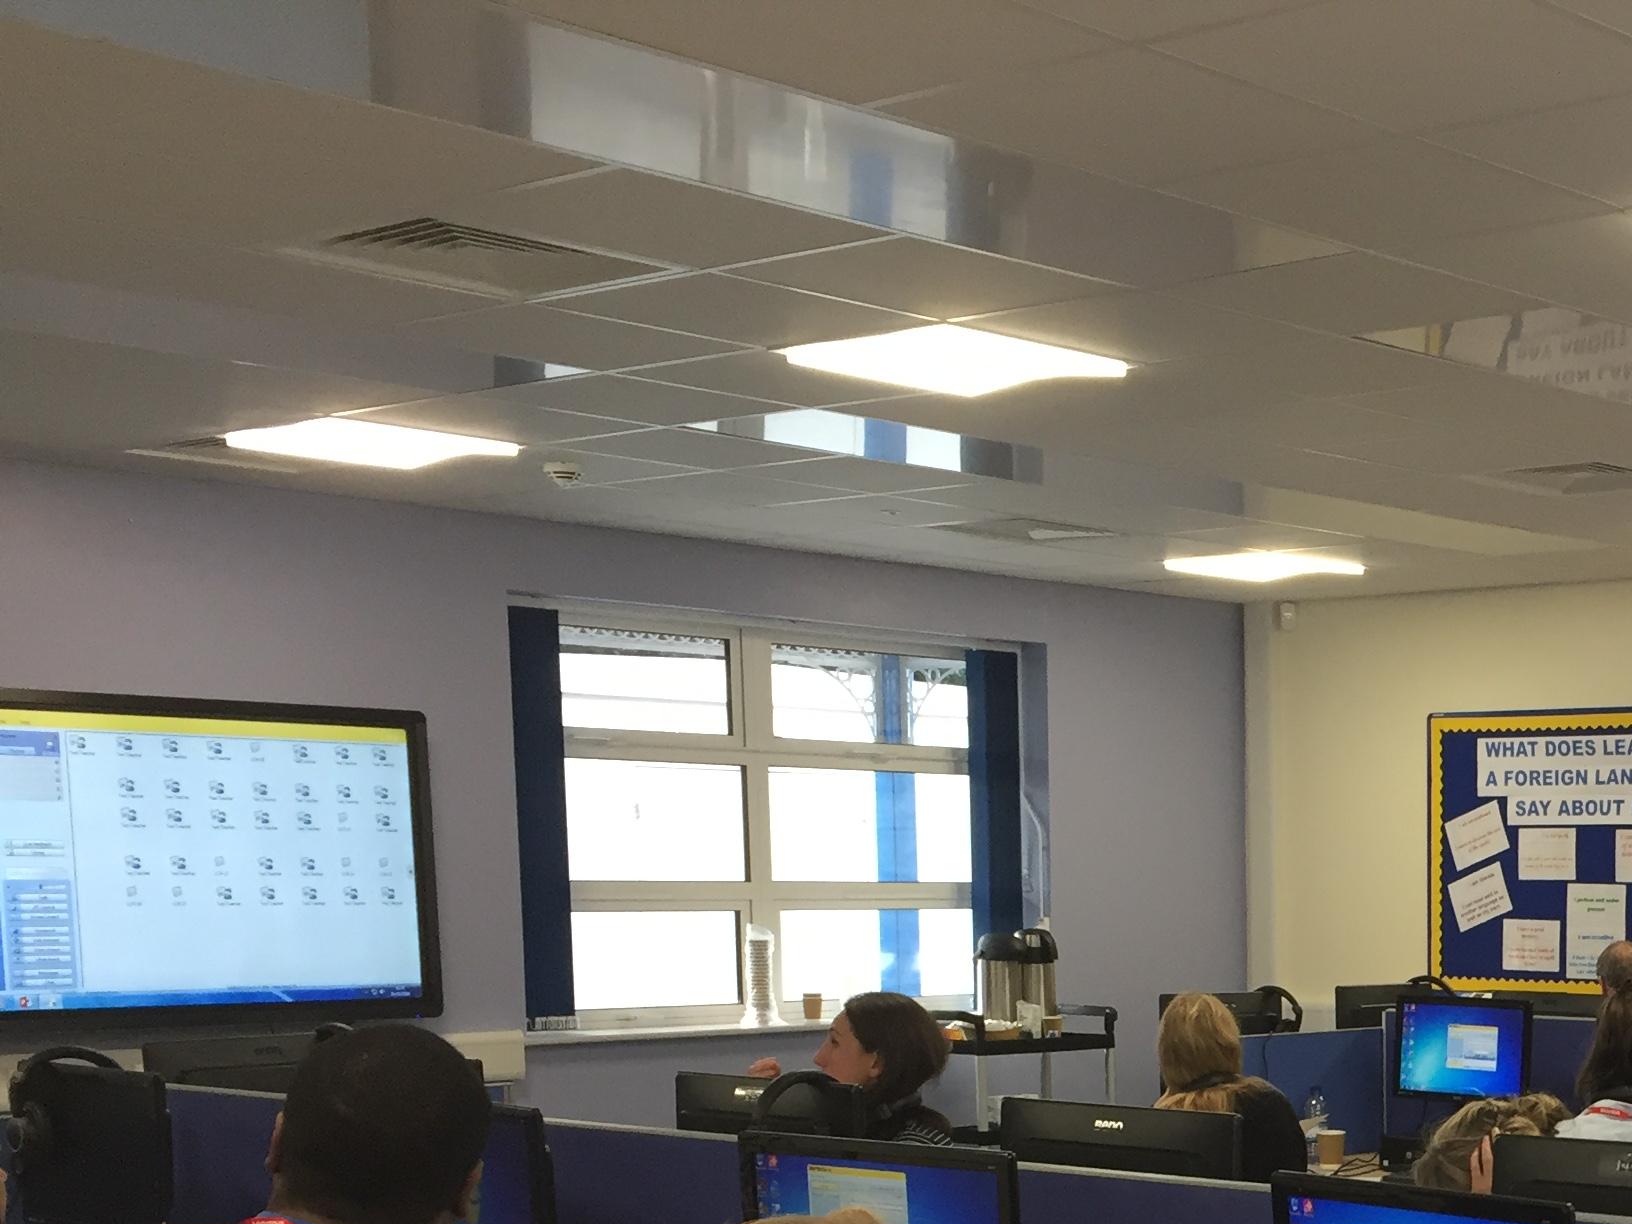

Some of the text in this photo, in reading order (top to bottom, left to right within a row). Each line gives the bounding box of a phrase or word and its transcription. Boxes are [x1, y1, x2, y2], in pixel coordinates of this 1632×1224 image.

[1485, 740, 1538, 758] WHAT
[1545, 739, 1597, 757] DOES
[1485, 771, 1498, 787] A
[1504, 769, 1588, 786] FOREIGN
[1515, 800, 1552, 817] SAY
[1558, 799, 1625, 816] ABOUT
